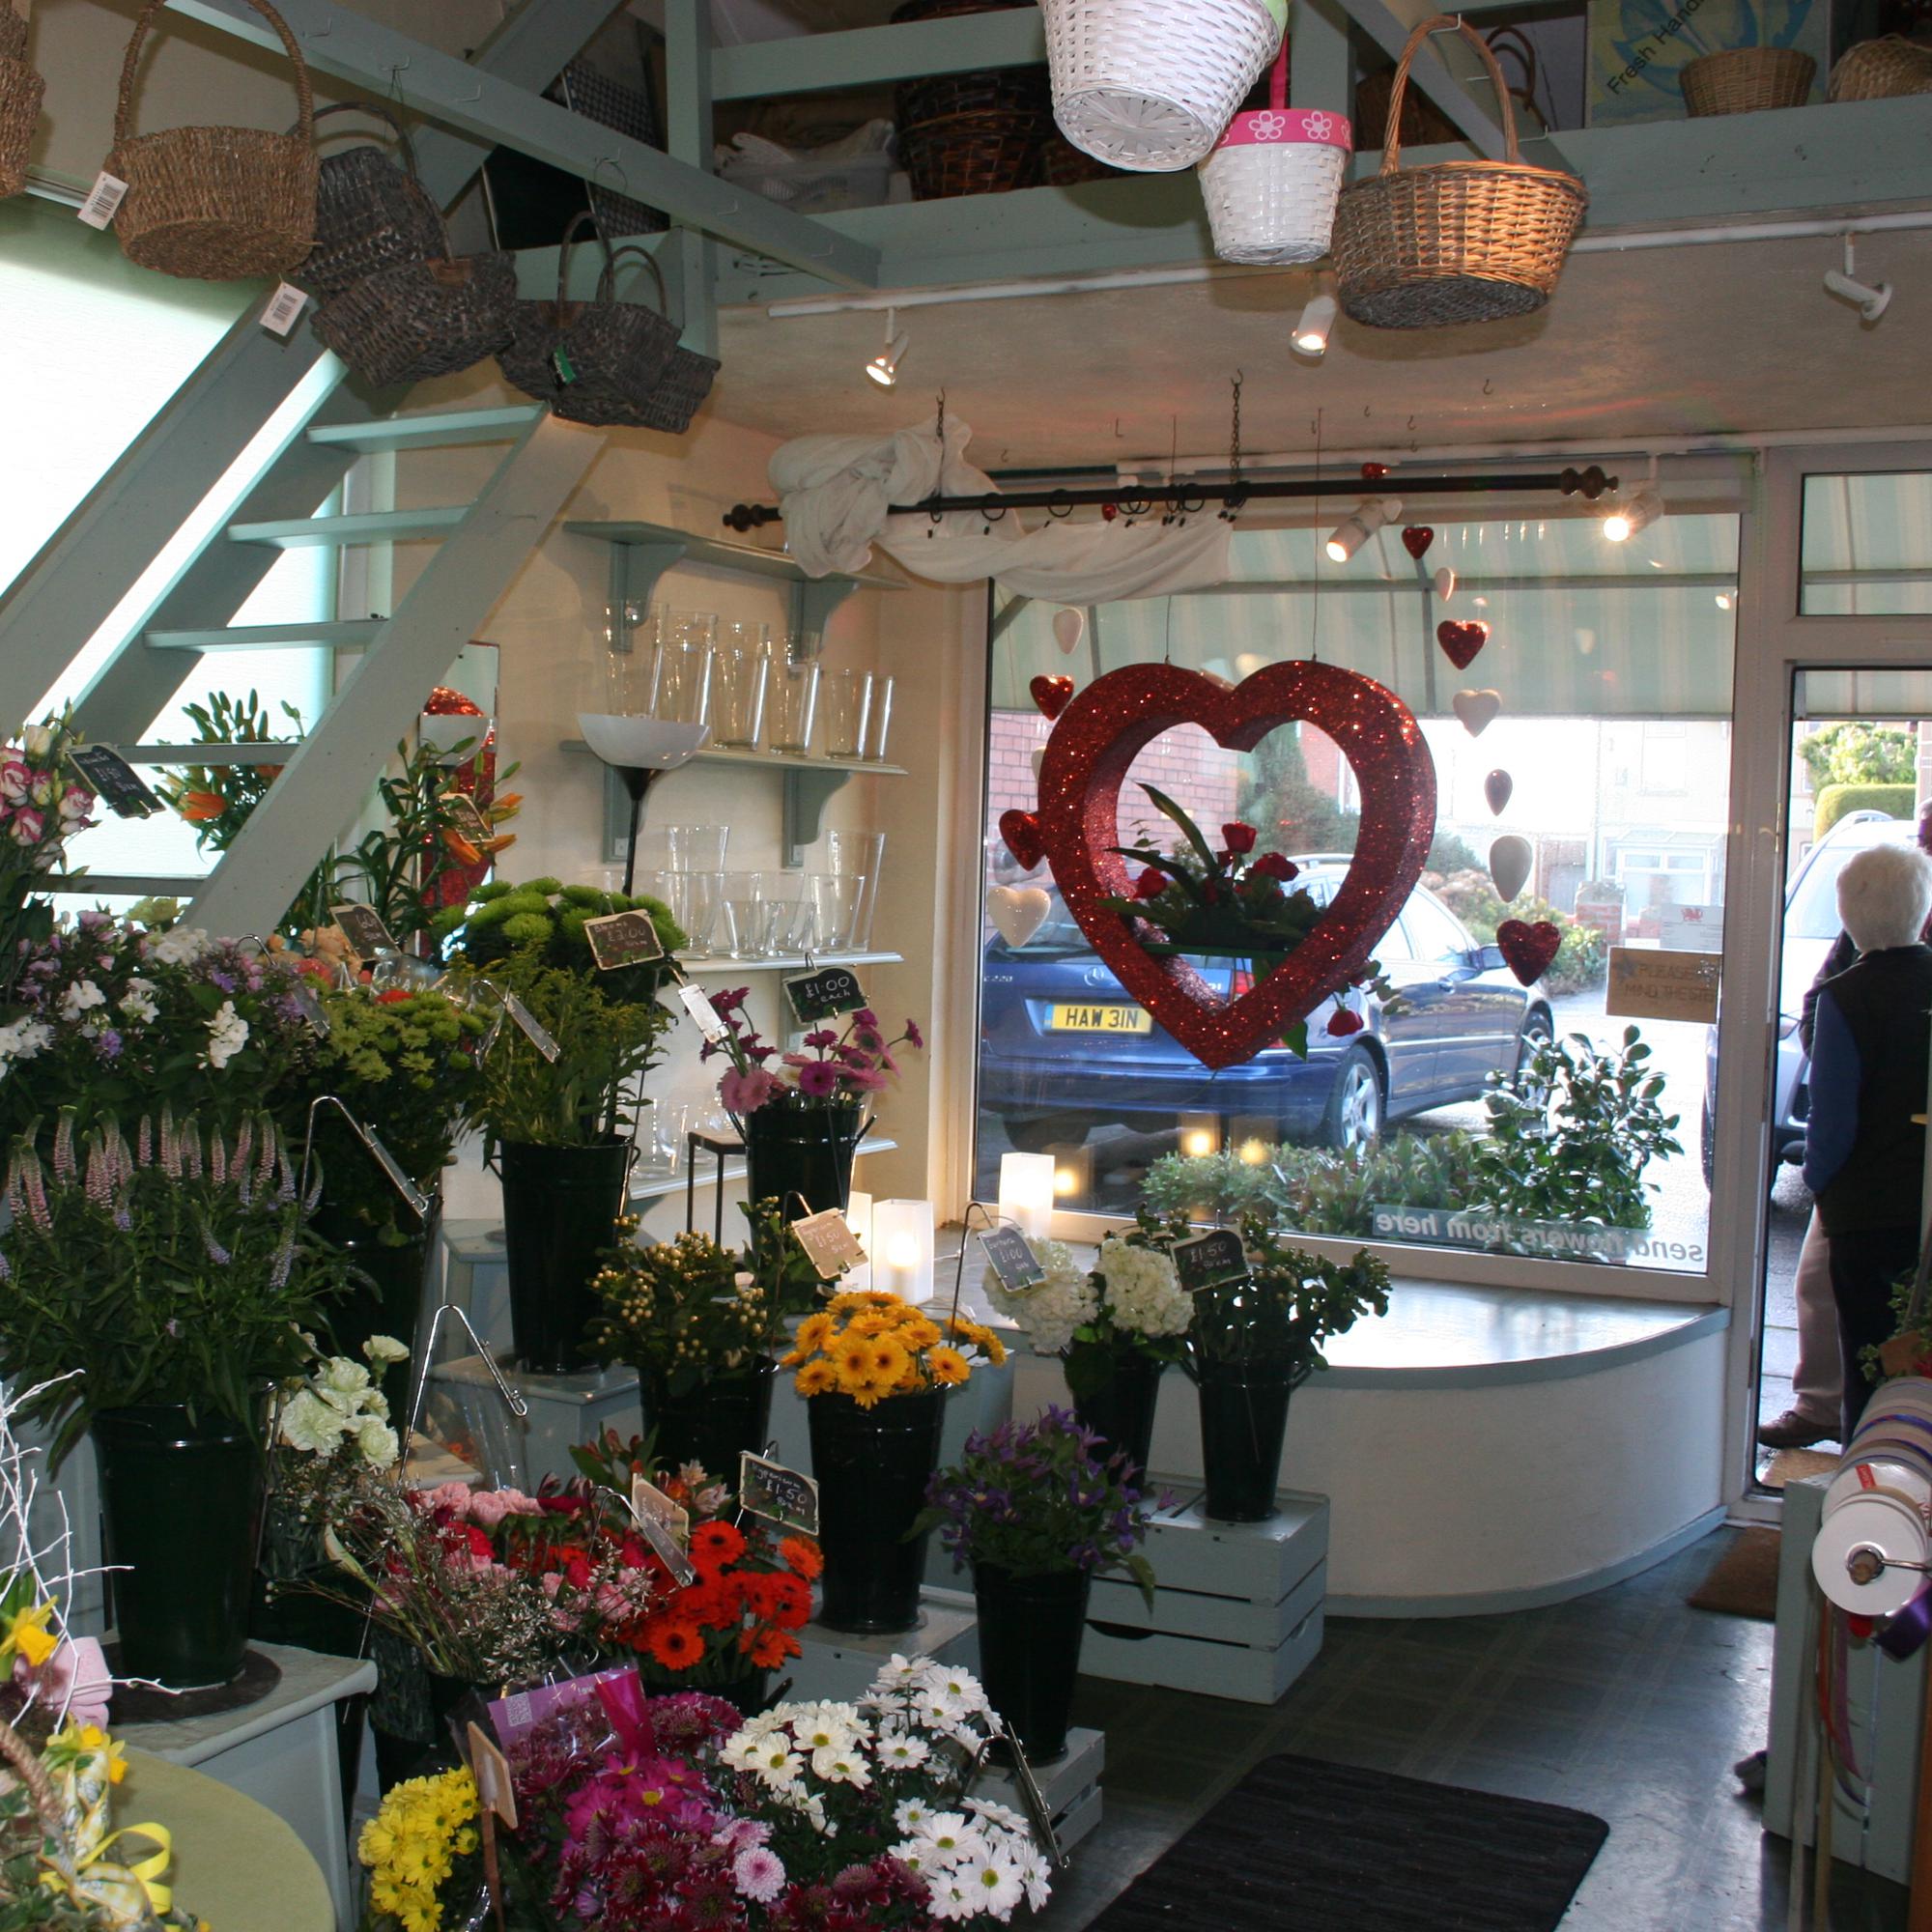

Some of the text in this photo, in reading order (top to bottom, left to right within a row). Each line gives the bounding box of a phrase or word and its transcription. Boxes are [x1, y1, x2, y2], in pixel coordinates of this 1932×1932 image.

[1606, 47, 1657, 95] Fresh
[805, 977, 849, 998] £1.00
[820, 989, 850, 1003] each
[1065, 1008, 1103, 1027] HAW
[766, 1479, 807, 1504] £1.50
